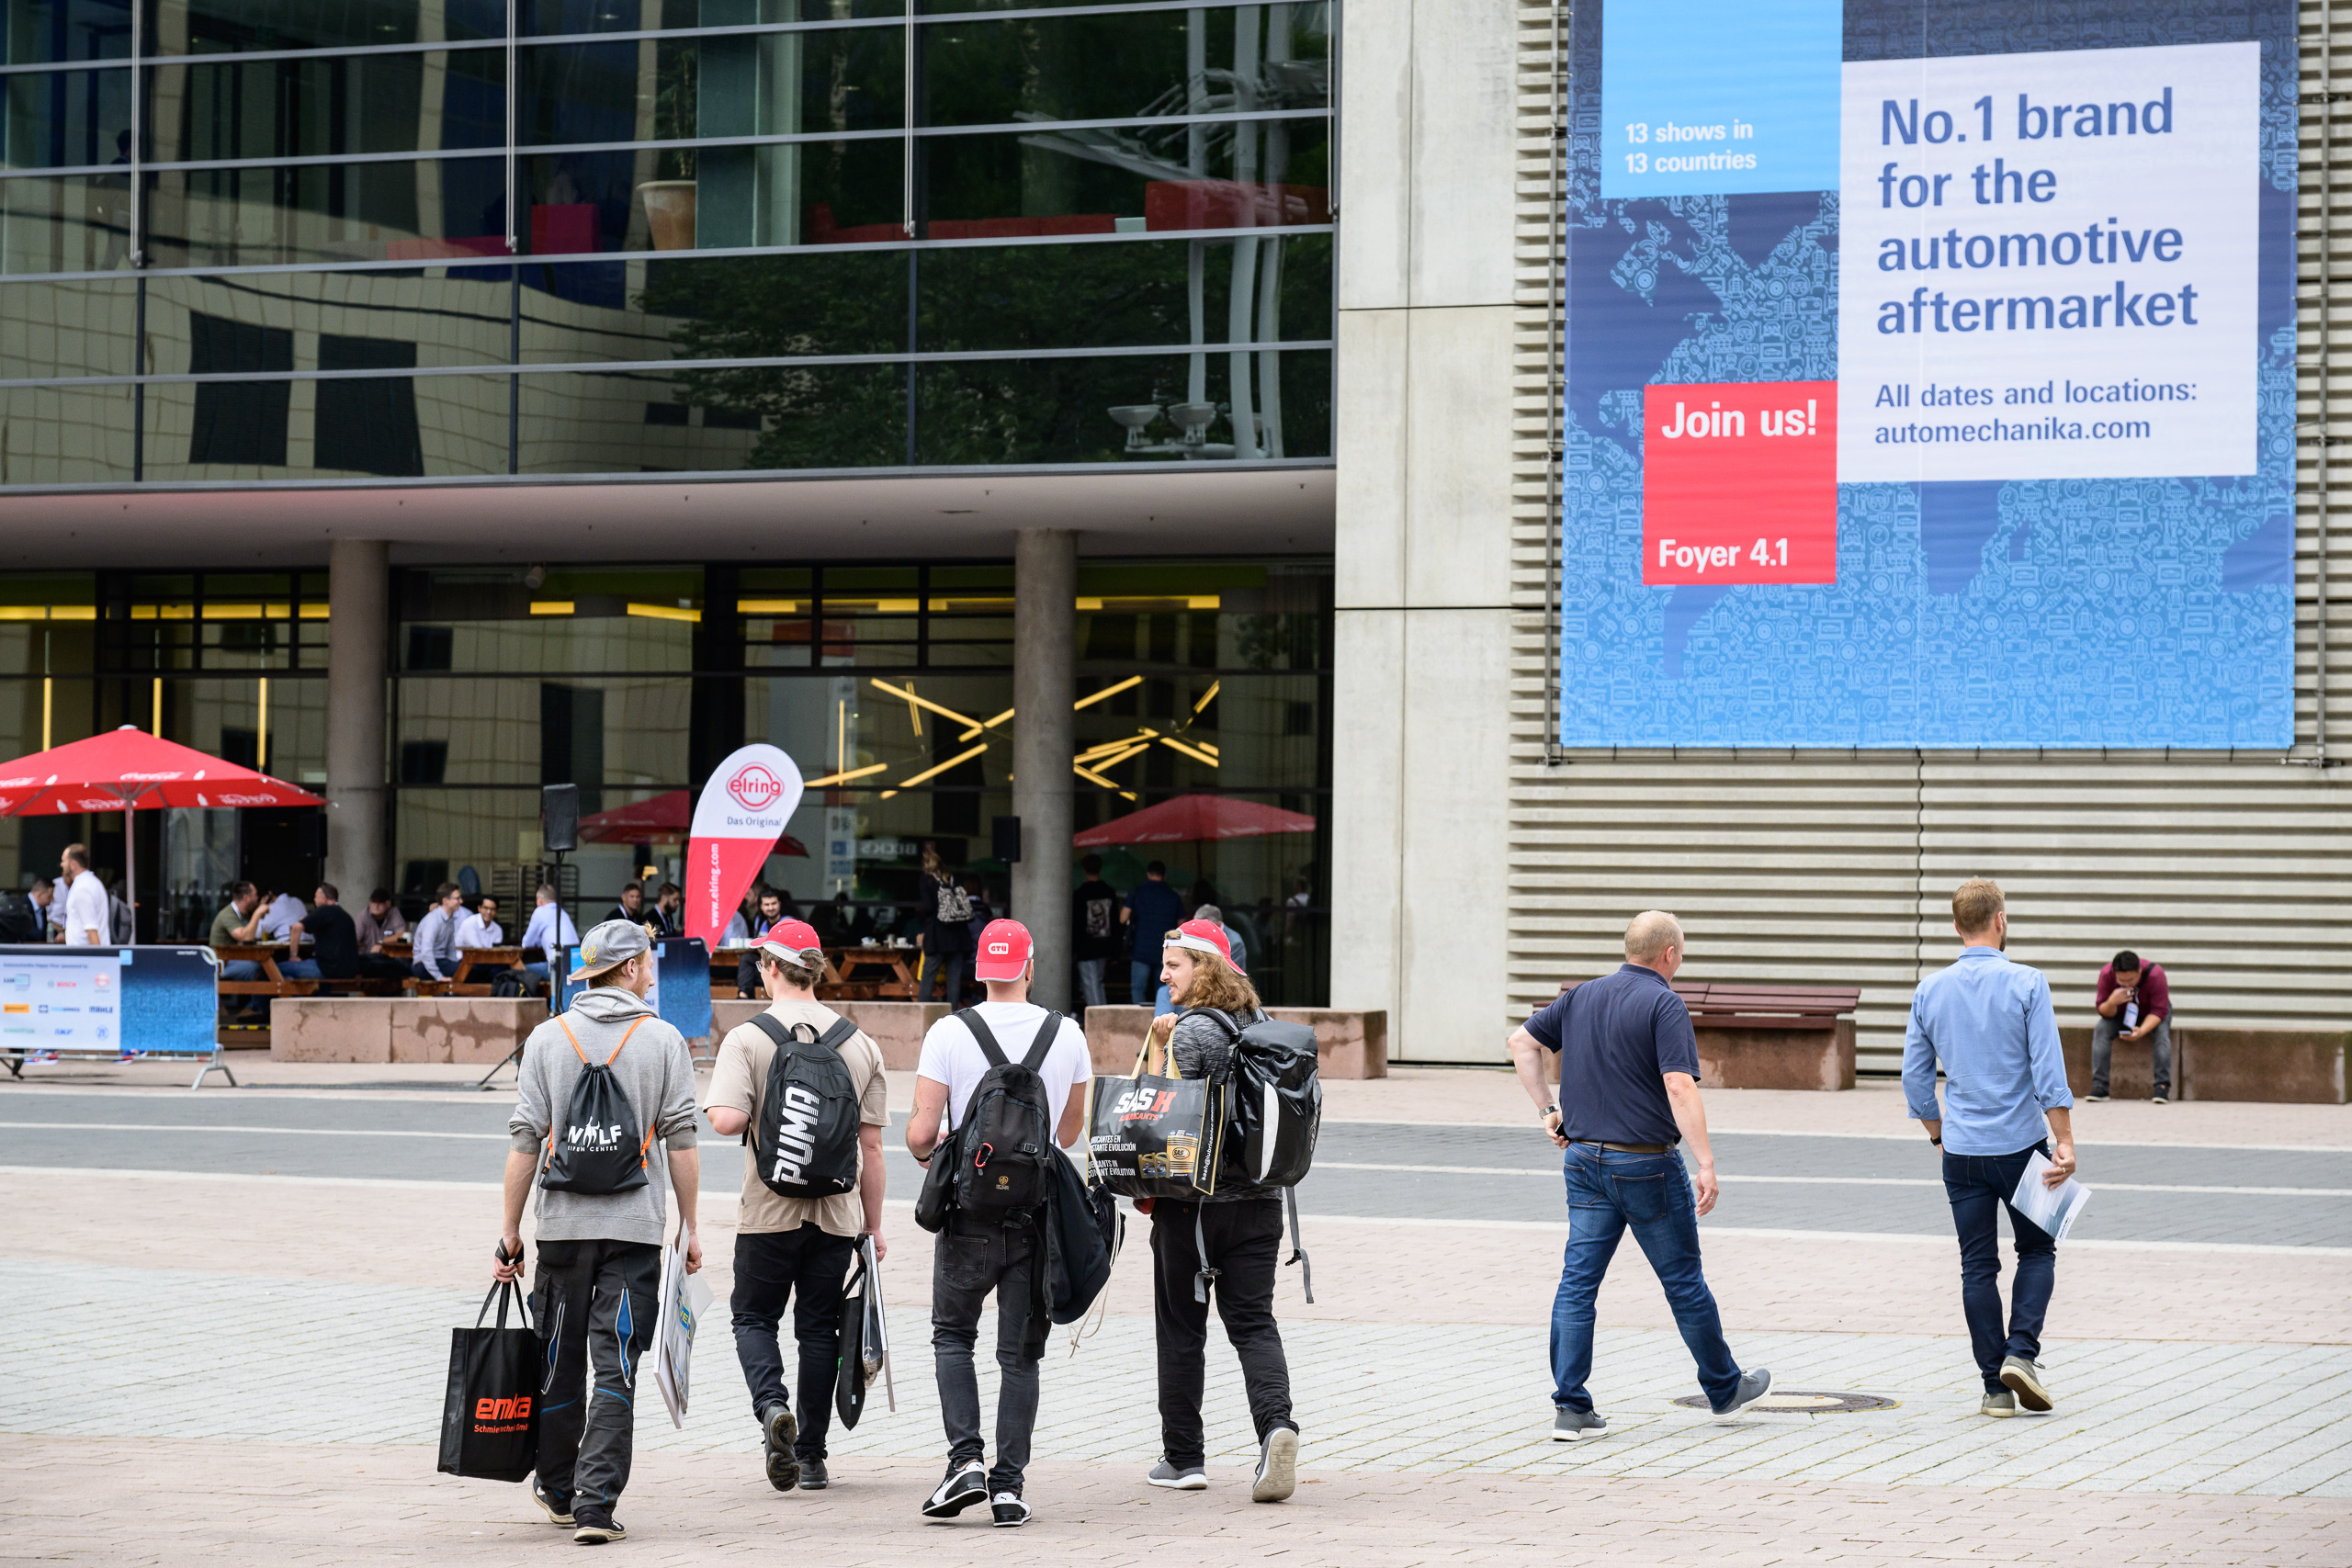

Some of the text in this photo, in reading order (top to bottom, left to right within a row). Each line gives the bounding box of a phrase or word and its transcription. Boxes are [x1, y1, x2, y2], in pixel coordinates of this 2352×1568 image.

[1883, 87, 2172, 145] No.1 brand
[1625, 118, 1753, 143] 13 shows in
[1625, 150, 1757, 174] 13 countries
[1878, 158, 2056, 208] for the
[1879, 218, 2183, 271] automotive
[1878, 281, 2198, 334] aftermarket
[1876, 378, 2196, 407] All dates and locations:
[1662, 400, 1816, 438] Join us!
[1876, 417, 2150, 443] automechanika.com
[1659, 538, 1788, 573] Foyer 4.1
[729, 777, 781, 796] elring
[727, 816, 743, 826] Das
[709, 843, 721, 928] www.elring.com
[1113, 1088, 1177, 1114] SASH
[1109, 1142, 1136, 1151] EVOLUCIÓN
[475, 1393, 532, 1420] emka
